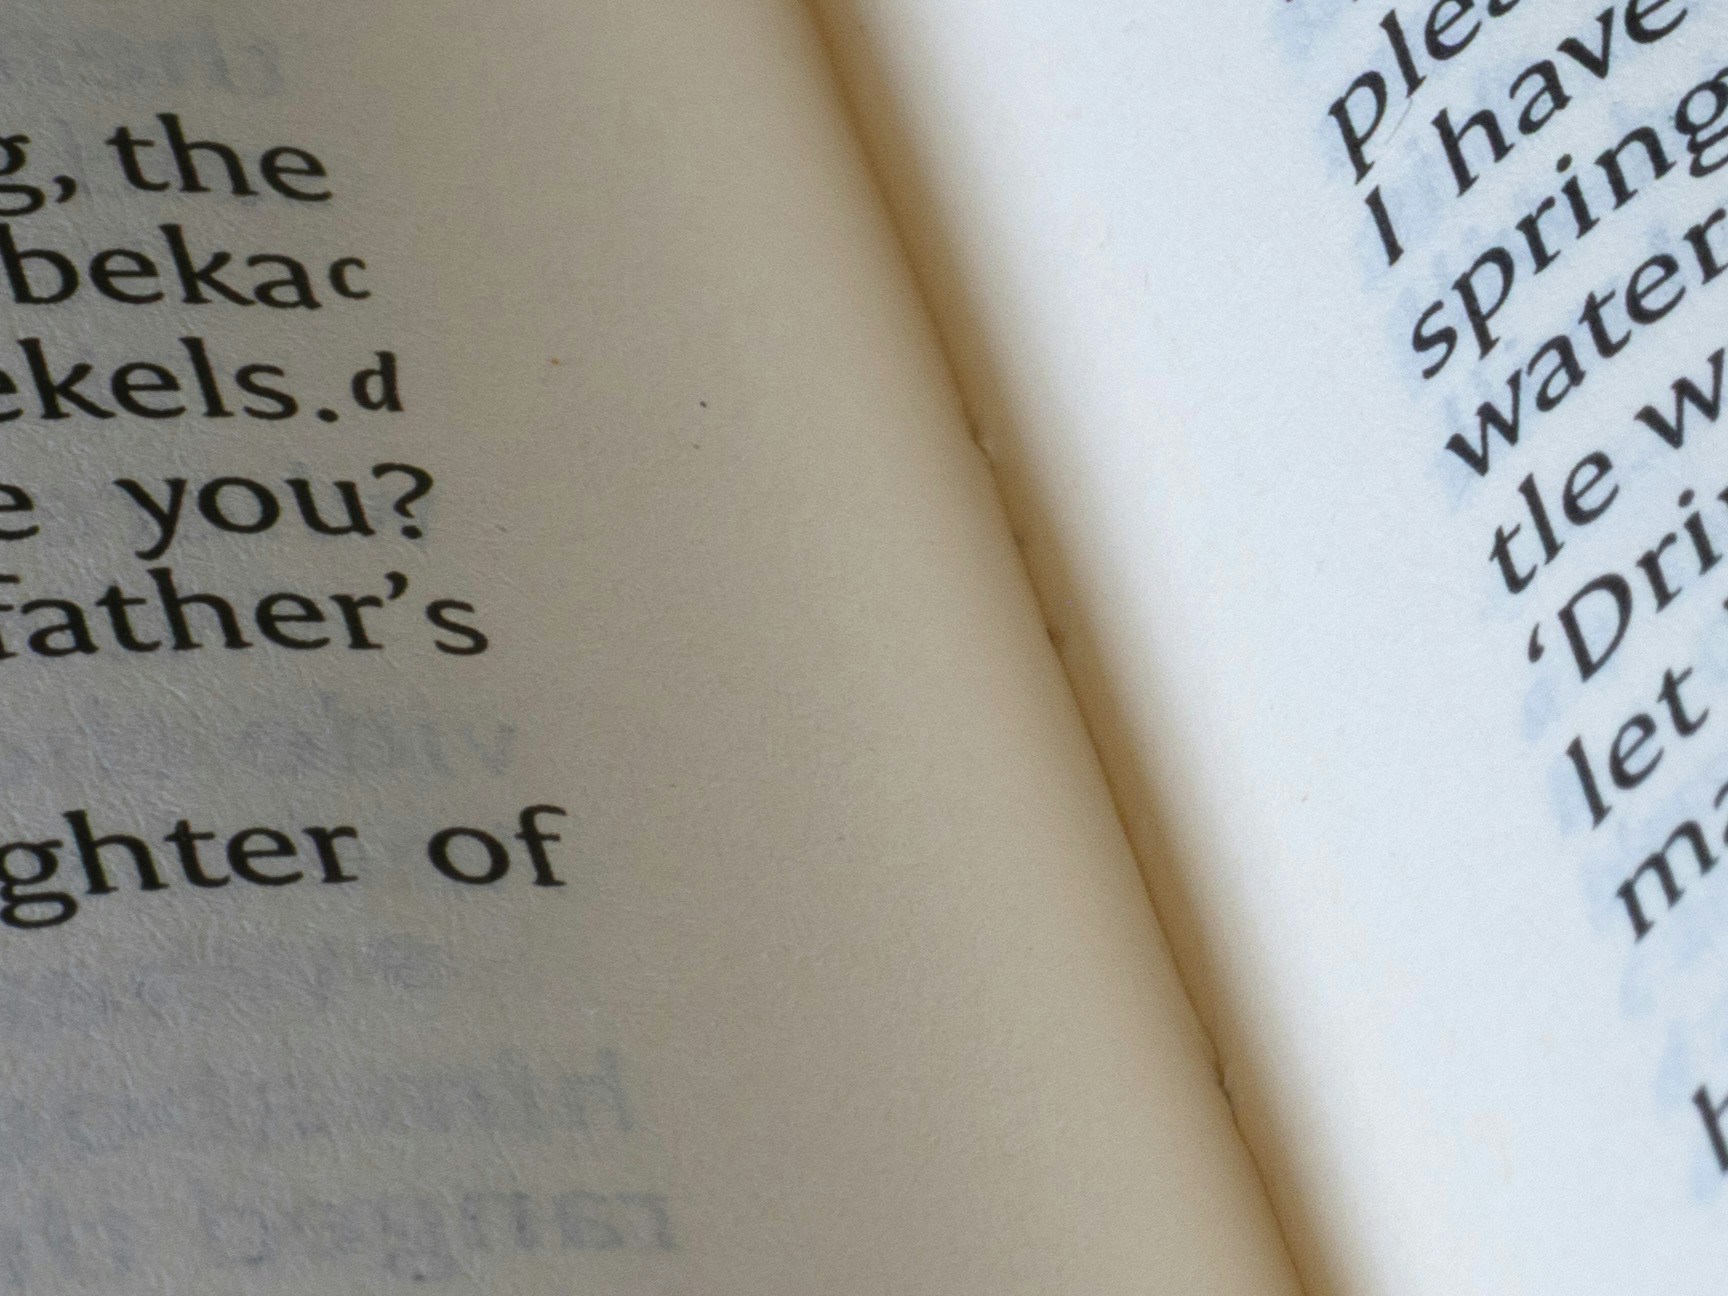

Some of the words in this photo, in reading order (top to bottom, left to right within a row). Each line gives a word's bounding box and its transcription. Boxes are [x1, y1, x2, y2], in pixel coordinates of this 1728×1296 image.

[102, 110, 335, 205] the
[110, 460, 436, 564] you?
[1564, 666, 1710, 829] let
[424, 801, 569, 890] of
